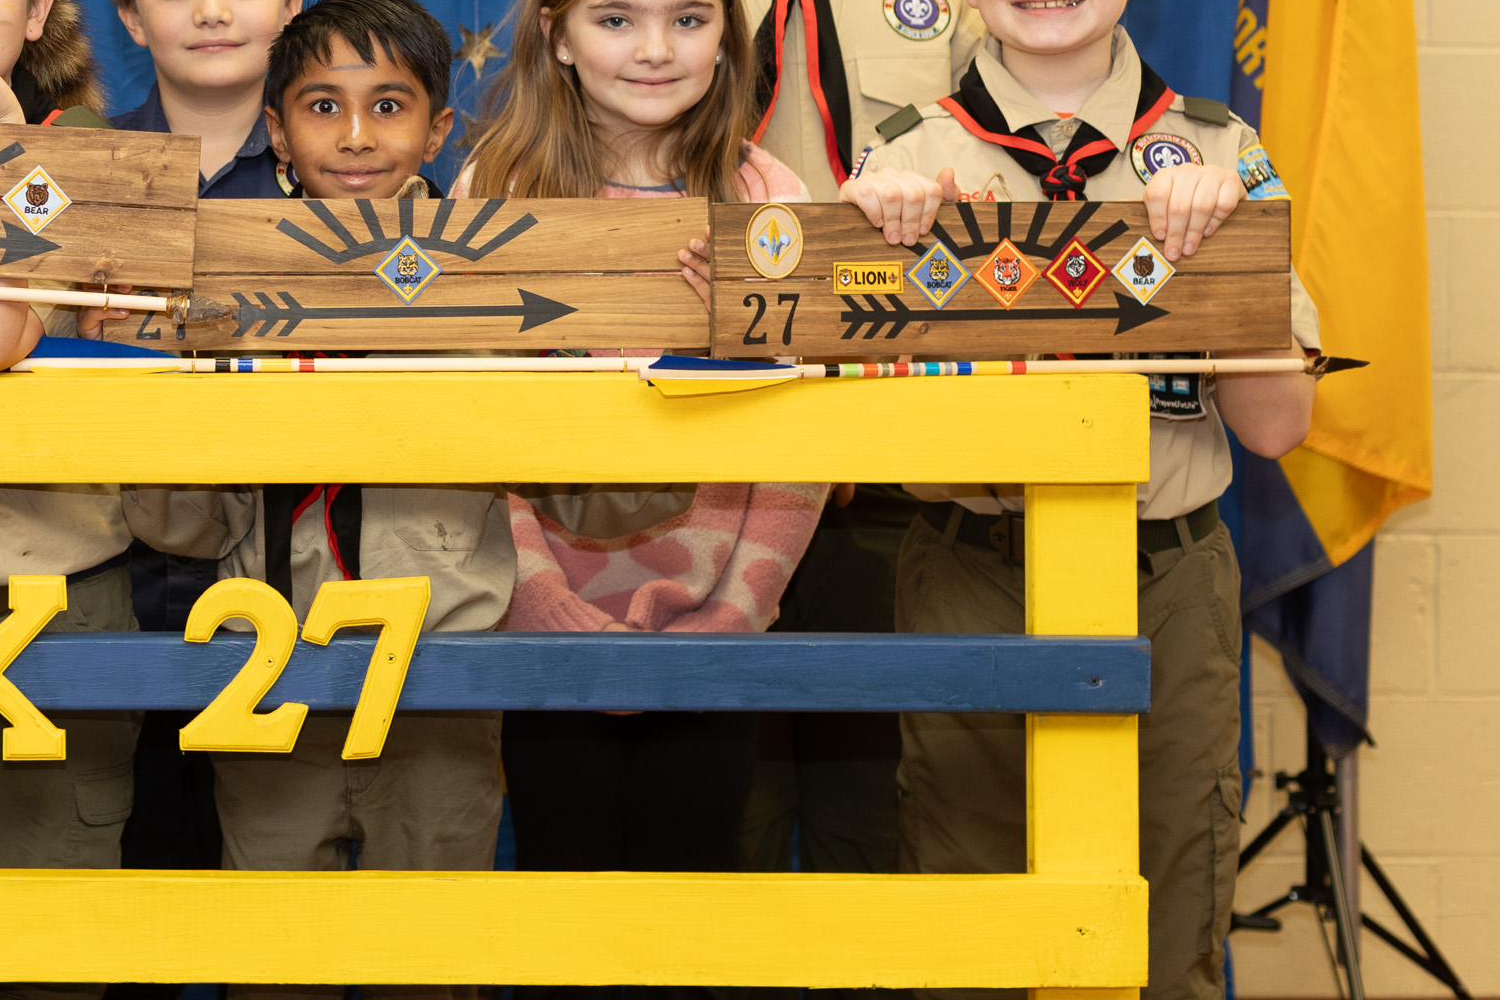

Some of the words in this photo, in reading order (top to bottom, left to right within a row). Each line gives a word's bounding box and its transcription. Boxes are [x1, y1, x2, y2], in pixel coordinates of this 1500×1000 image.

[24, 206, 49, 216] BEAR
[394, 276, 422, 284] BOBCAT
[854, 271, 887, 285] LION
[1132, 277, 1156, 286] BEAR
[926, 281, 953, 289] BOBCAT
[1067, 279, 1089, 287] WOLF
[742, 293, 800, 346] 27
[179, 575, 431, 760] 27
